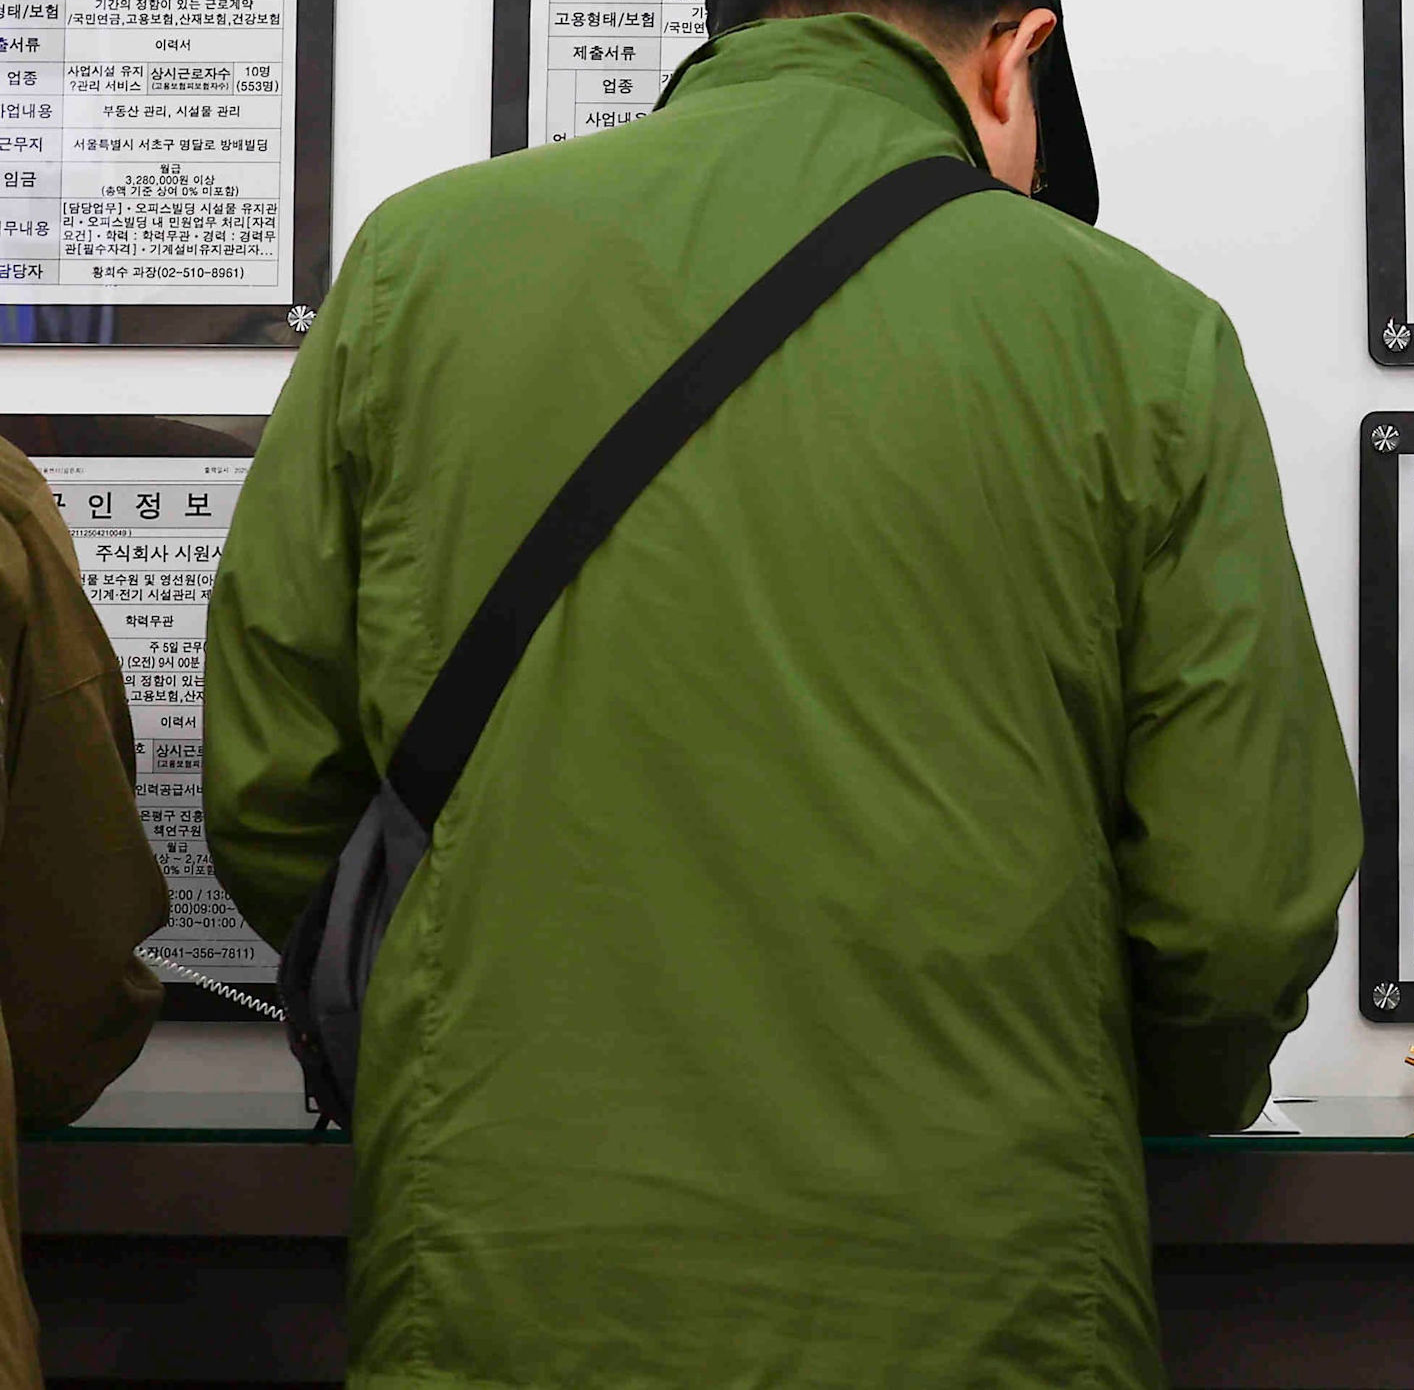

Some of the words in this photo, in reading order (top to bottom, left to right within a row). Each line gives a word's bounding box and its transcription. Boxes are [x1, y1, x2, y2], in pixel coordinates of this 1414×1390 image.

[573, 45, 636, 62] 제출서류
[245, 65, 271, 78] 10명
[602, 78, 634, 95] 업종
[103, 105, 140, 118] 부동산
[176, 105, 213, 118] 시설물
[216, 105, 240, 118] 관리
[73, 138, 134, 152] 서울특별시
[138, 138, 176, 152] 서초구
[179, 138, 216, 152] 명달로
[220, 138, 268, 152] 방배빌딩
[95, 544, 169, 563] 주식회사
[125, 614, 174, 628] 학력무관
[160, 715, 196, 729] 이력서
